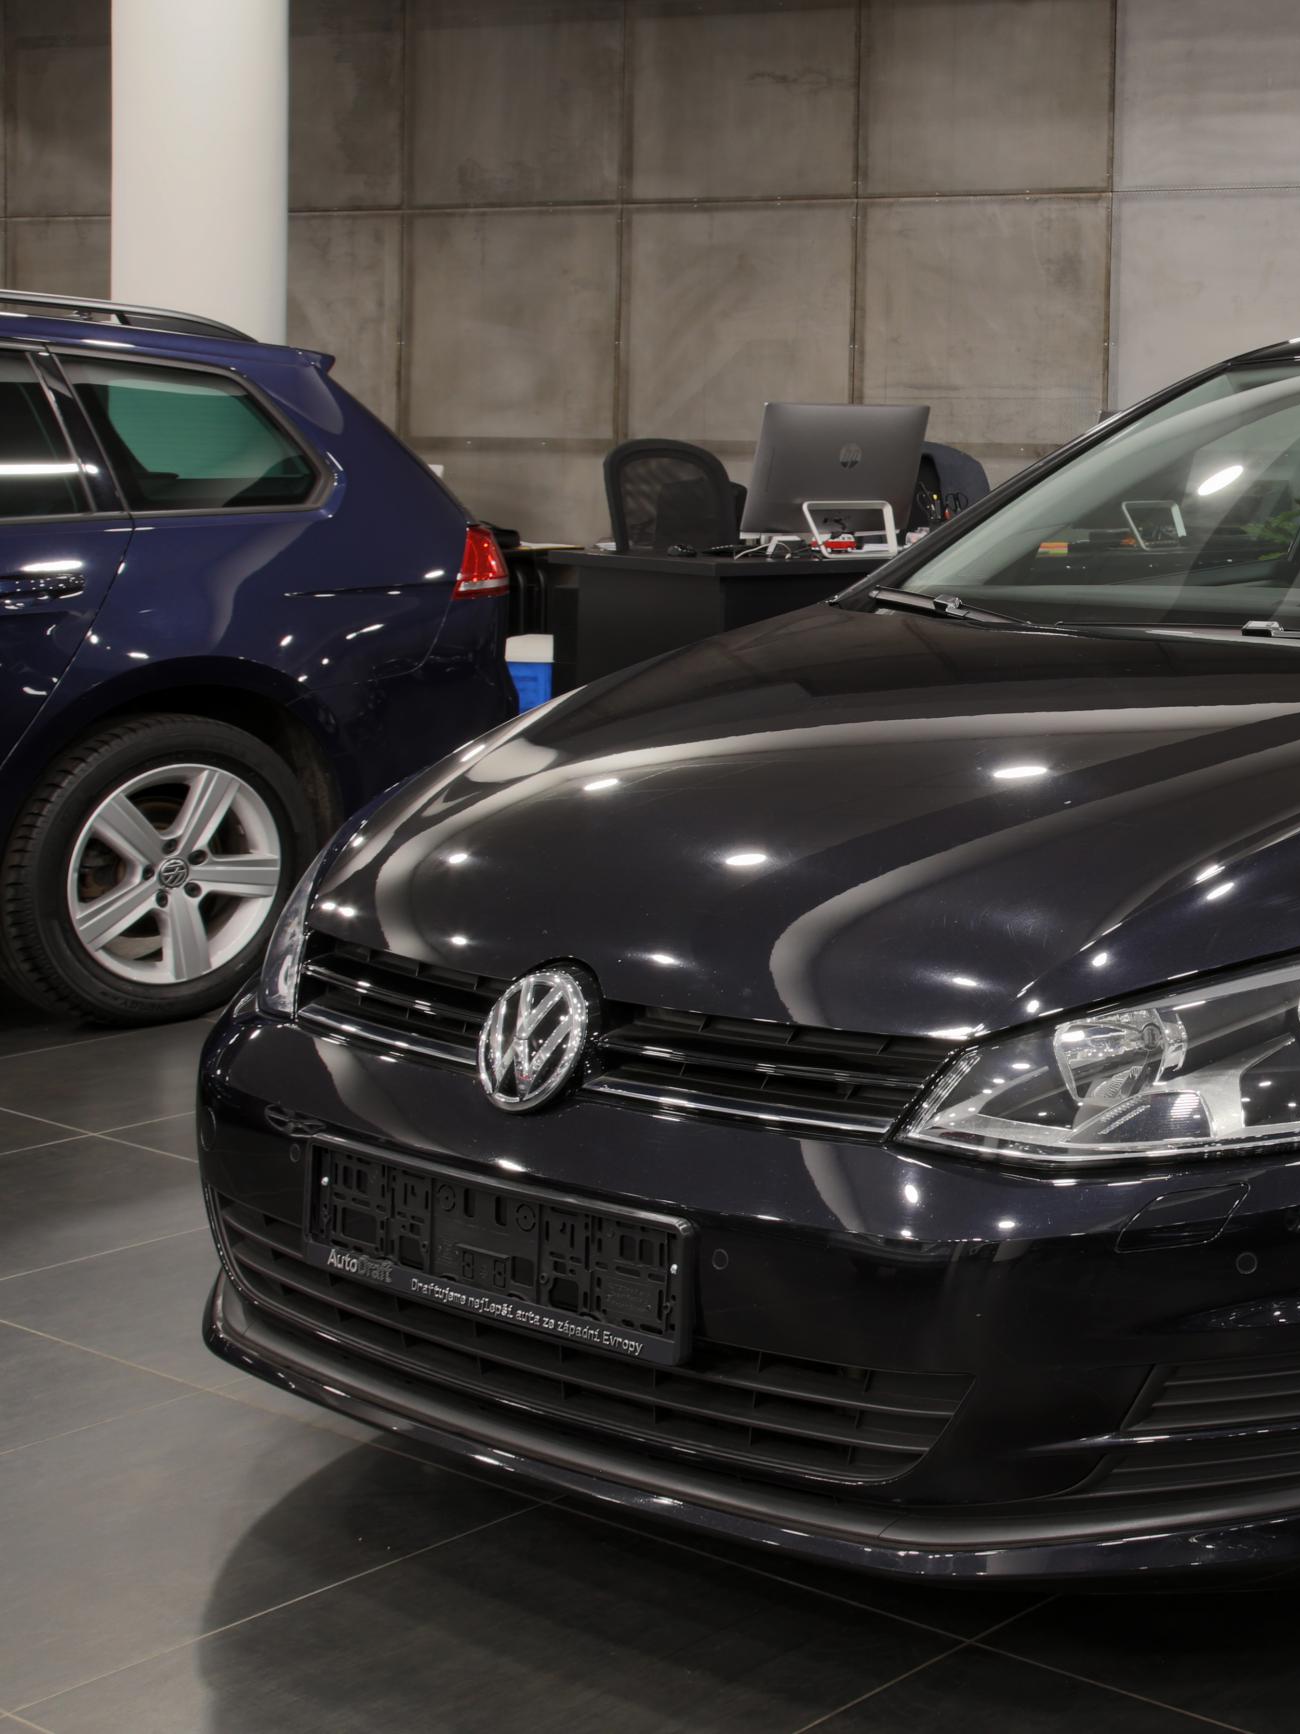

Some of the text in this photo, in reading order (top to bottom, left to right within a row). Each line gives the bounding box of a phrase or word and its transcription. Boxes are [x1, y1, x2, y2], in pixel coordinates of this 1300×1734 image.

[411, 1278, 466, 1305] Draftujeme
[515, 1310, 541, 1326] auta
[557, 1320, 600, 1342] západní
[602, 1330, 643, 1356] Evropy
